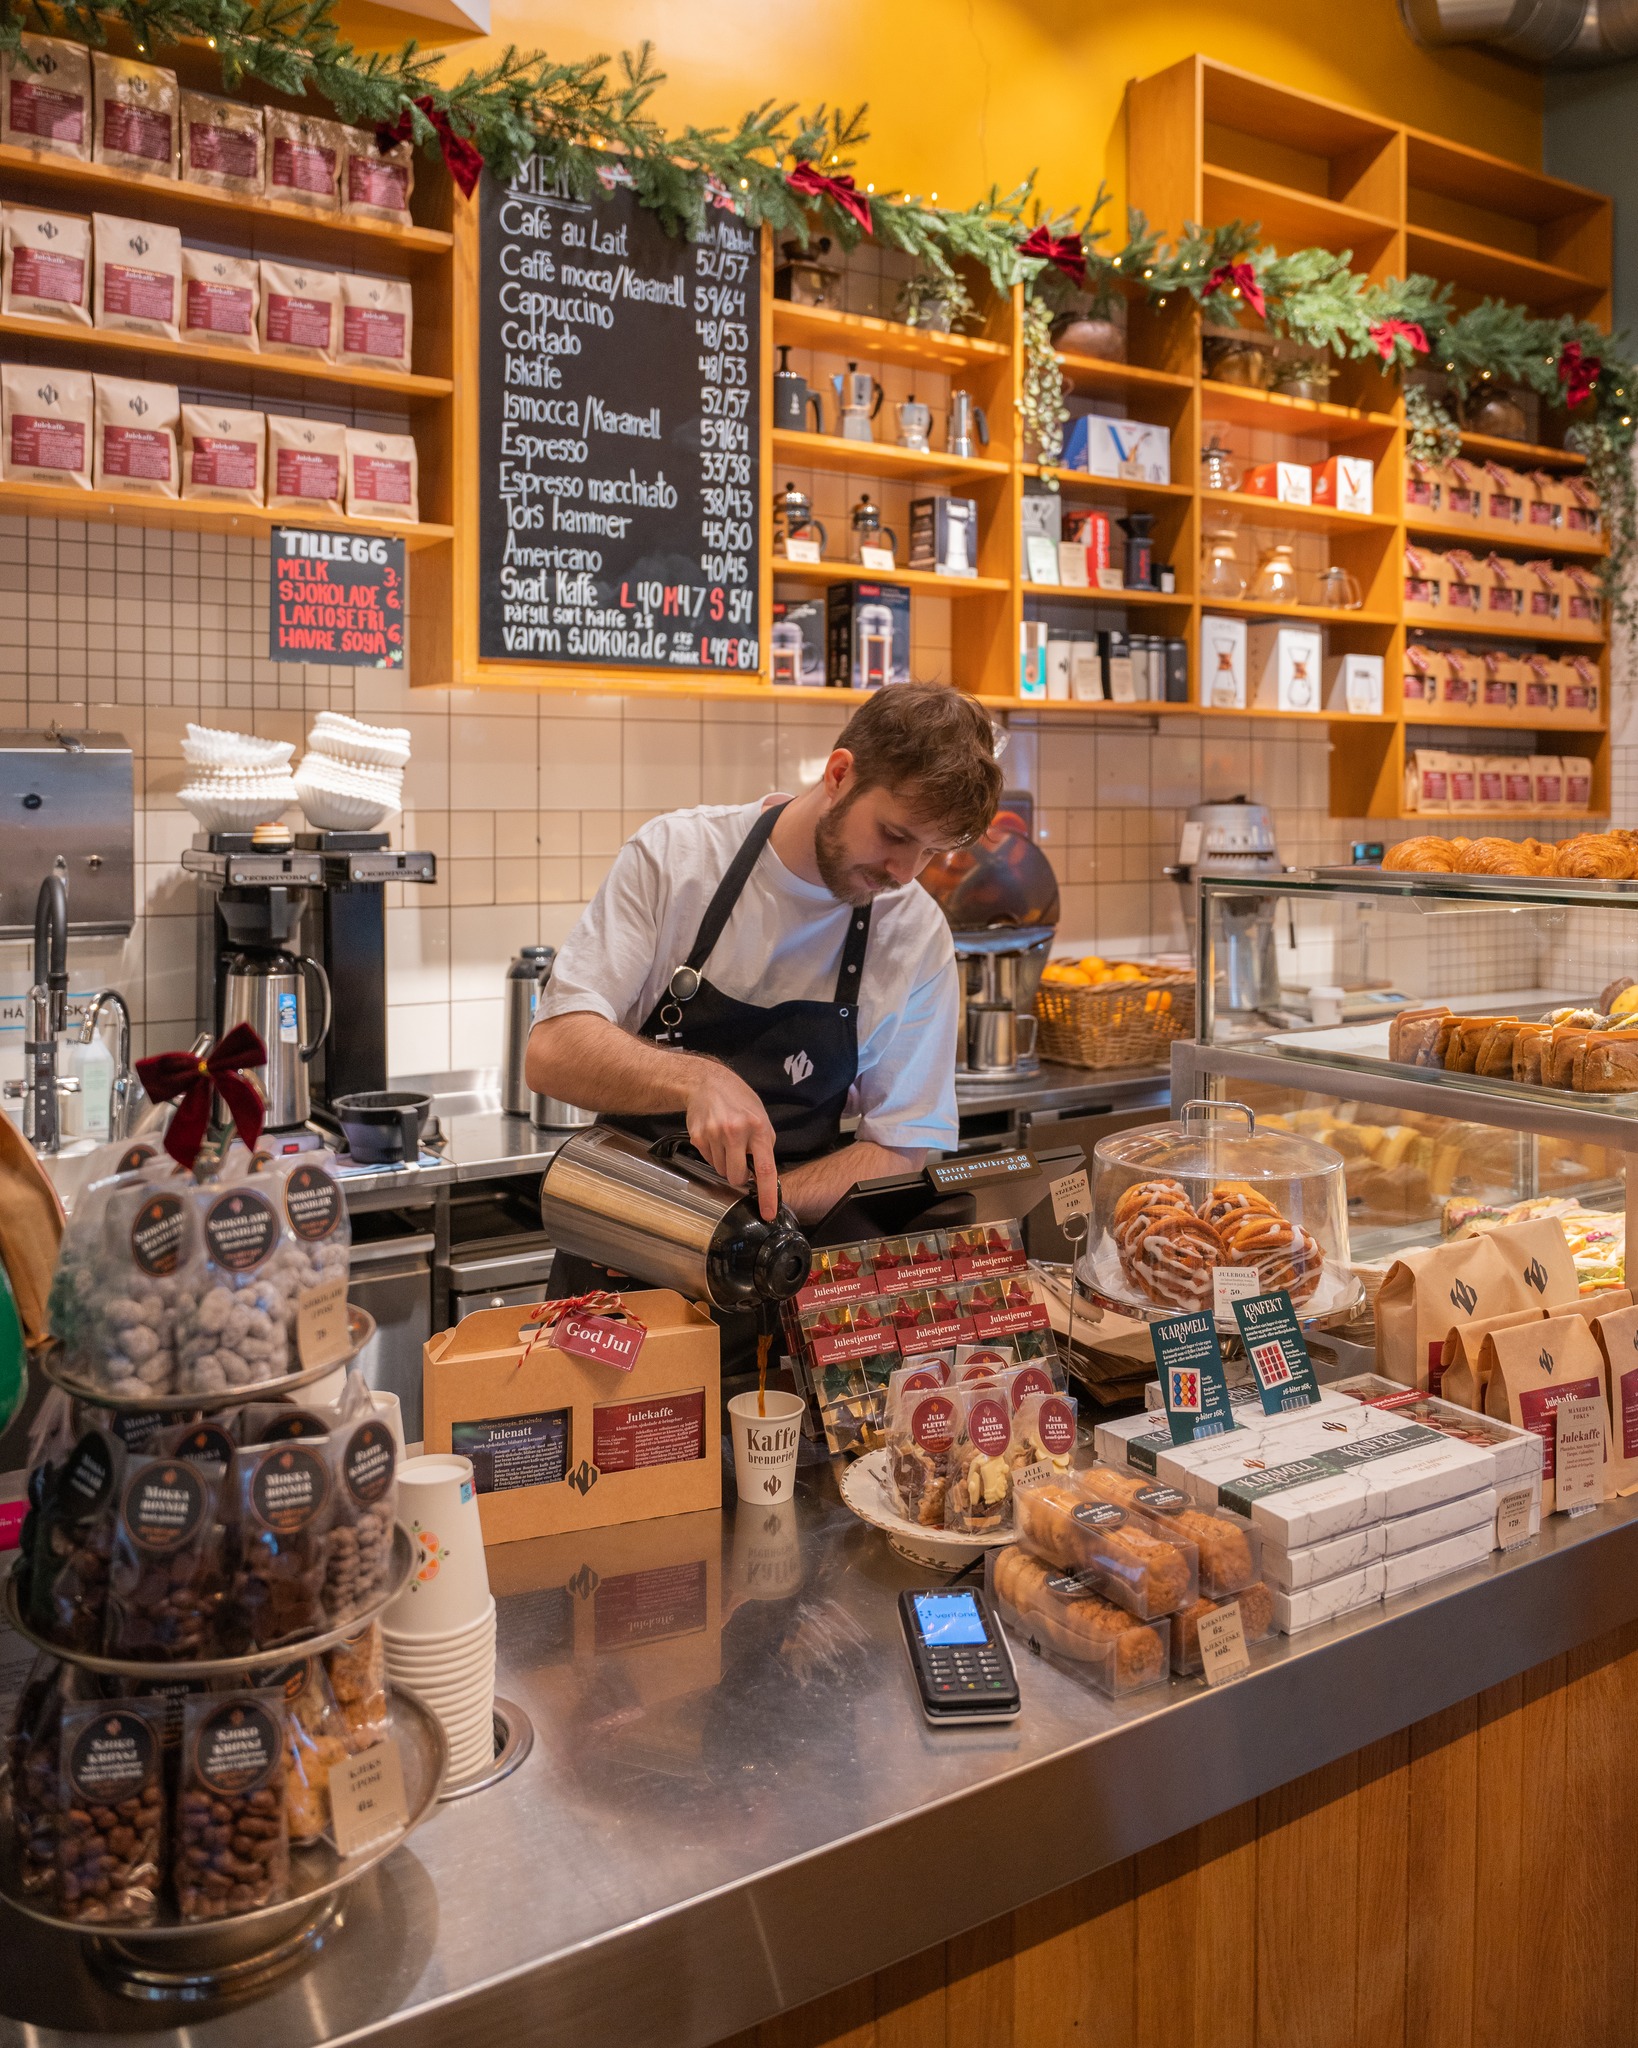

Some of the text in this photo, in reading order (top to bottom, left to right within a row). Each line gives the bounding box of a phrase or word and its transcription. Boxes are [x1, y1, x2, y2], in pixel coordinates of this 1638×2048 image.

[511, 153, 584, 199] MEN
[500, 200, 749, 283] Café au Lait 52/57
[693, 285, 745, 317] 59/64
[499, 281, 749, 352] Cappuccino 48/53
[500, 321, 747, 386] Cortado 48/53
[505, 352, 750, 419] Iskaffe 52/57
[503, 390, 579, 428] Ismocca
[700, 418, 749, 451] 59/64
[501, 422, 750, 486] Espresso 33/38
[499, 461, 753, 517] Espresso macchiato 38/43
[499, 493, 753, 551] Tors hammer 45/50
[279, 531, 388, 565] TILLEGG
[503, 528, 748, 584] Americano 40/45
[277, 558, 329, 581] MELK
[278, 580, 380, 610] SJOKOLADE
[500, 566, 549, 604] Svart
[556, 570, 599, 607] Kaffe
[728, 588, 753, 625] 54
[936, 1165, 965, 1176] Ekstra
[1007, 1162, 1031, 1171] 60.00
[897, 1265, 942, 1280] Julestjerner
[971, 1255, 1013, 1269] Julestjerner
[813, 1282, 861, 1298] Julestjerner
[990, 1309, 1033, 1325] Julestjerner
[1243, 1297, 1283, 1324] KONFEKT
[566, 1321, 632, 1356] God Jul
[834, 1331, 882, 1350] Julestjerner
[916, 1323, 961, 1339] Julestjerner
[1157, 1317, 1209, 1344] KARAMELL
[1024, 1384, 1039, 1392] JULE
[626, 1407, 674, 1424] Julekaffe
[927, 1413, 945, 1421] JULE
[978, 1423, 1003, 1432] PLETTER
[488, 1427, 532, 1442] Julenatt
[746, 1427, 796, 1452] Kaffe
[1337, 1432, 1407, 1458] KONFEKT
[1560, 1428, 1600, 1444] Julekaffe
[748, 1449, 795, 1465] brenneriet
[1024, 1466, 1043, 1478] JULE
[1236, 1461, 1318, 1488] KARAMELL
[935, 1611, 976, 1619] verifone
